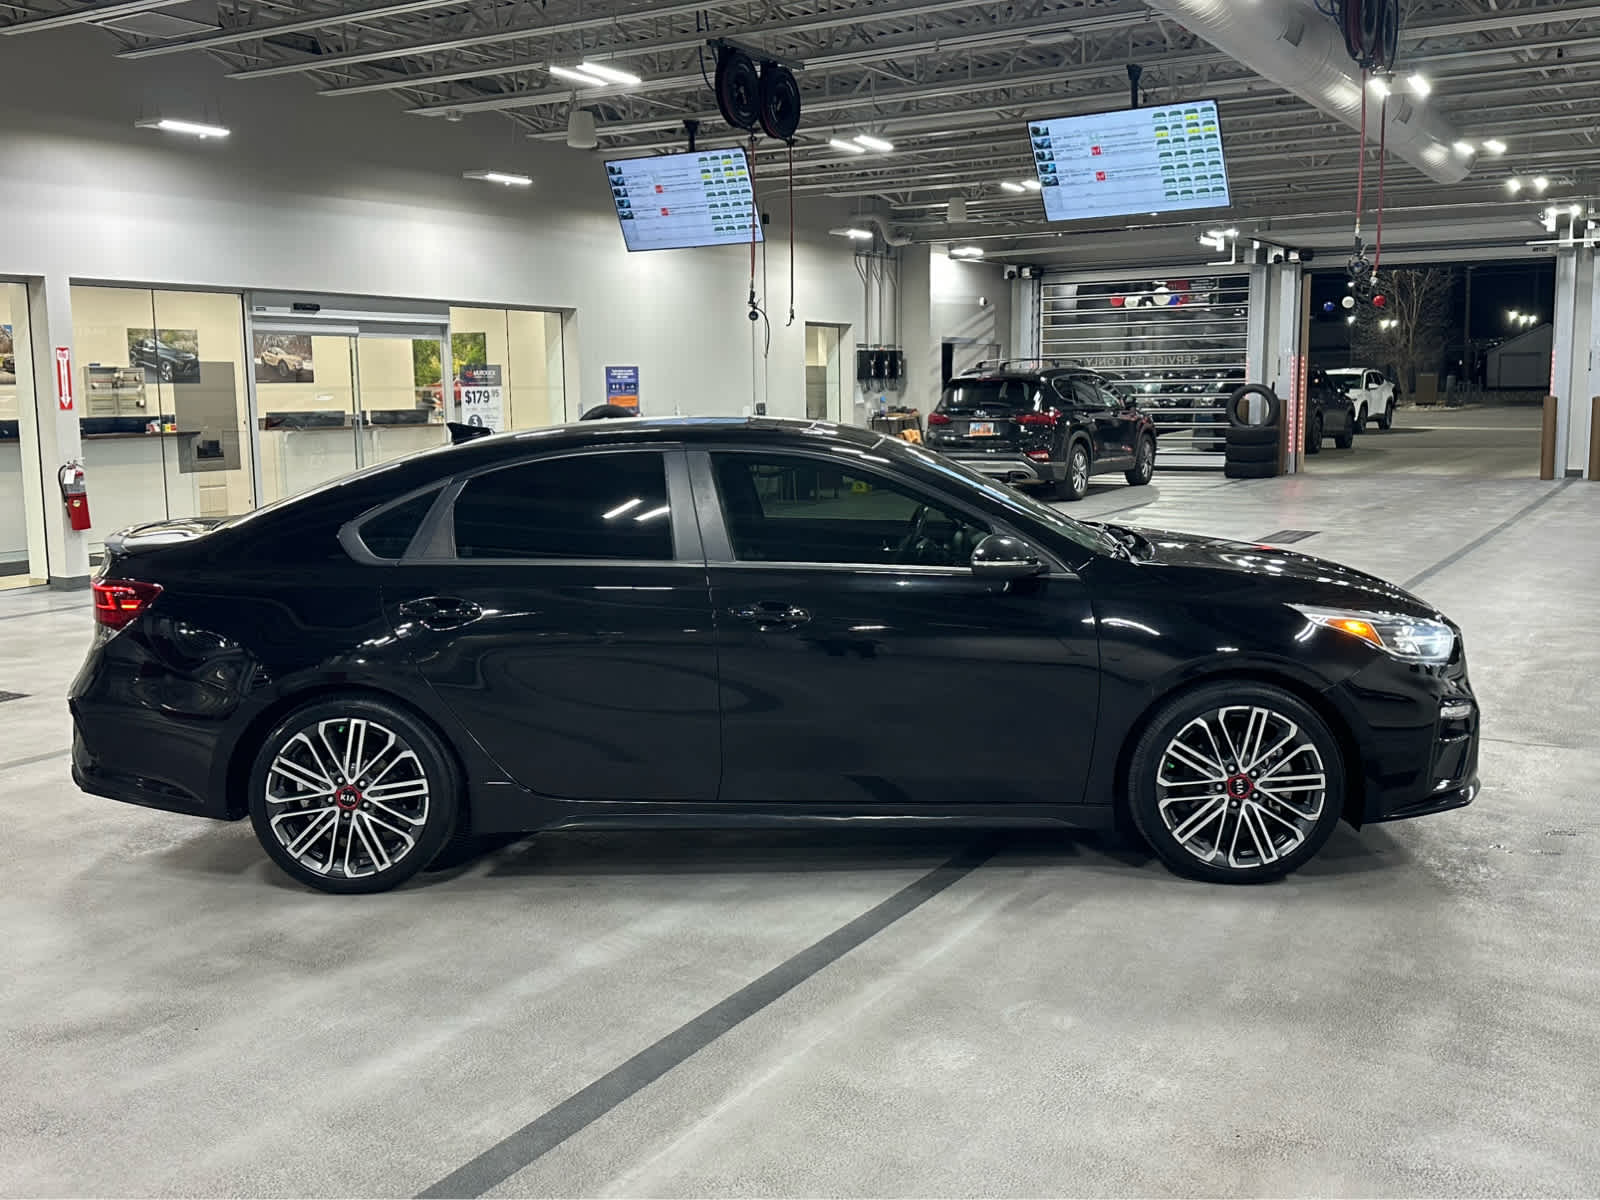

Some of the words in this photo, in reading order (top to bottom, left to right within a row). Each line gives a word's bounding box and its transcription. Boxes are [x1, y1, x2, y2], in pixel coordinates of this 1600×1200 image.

[465, 390, 490, 405] $179
[1235, 778, 1244, 795] KIA
[340, 793, 356, 802] KIA
